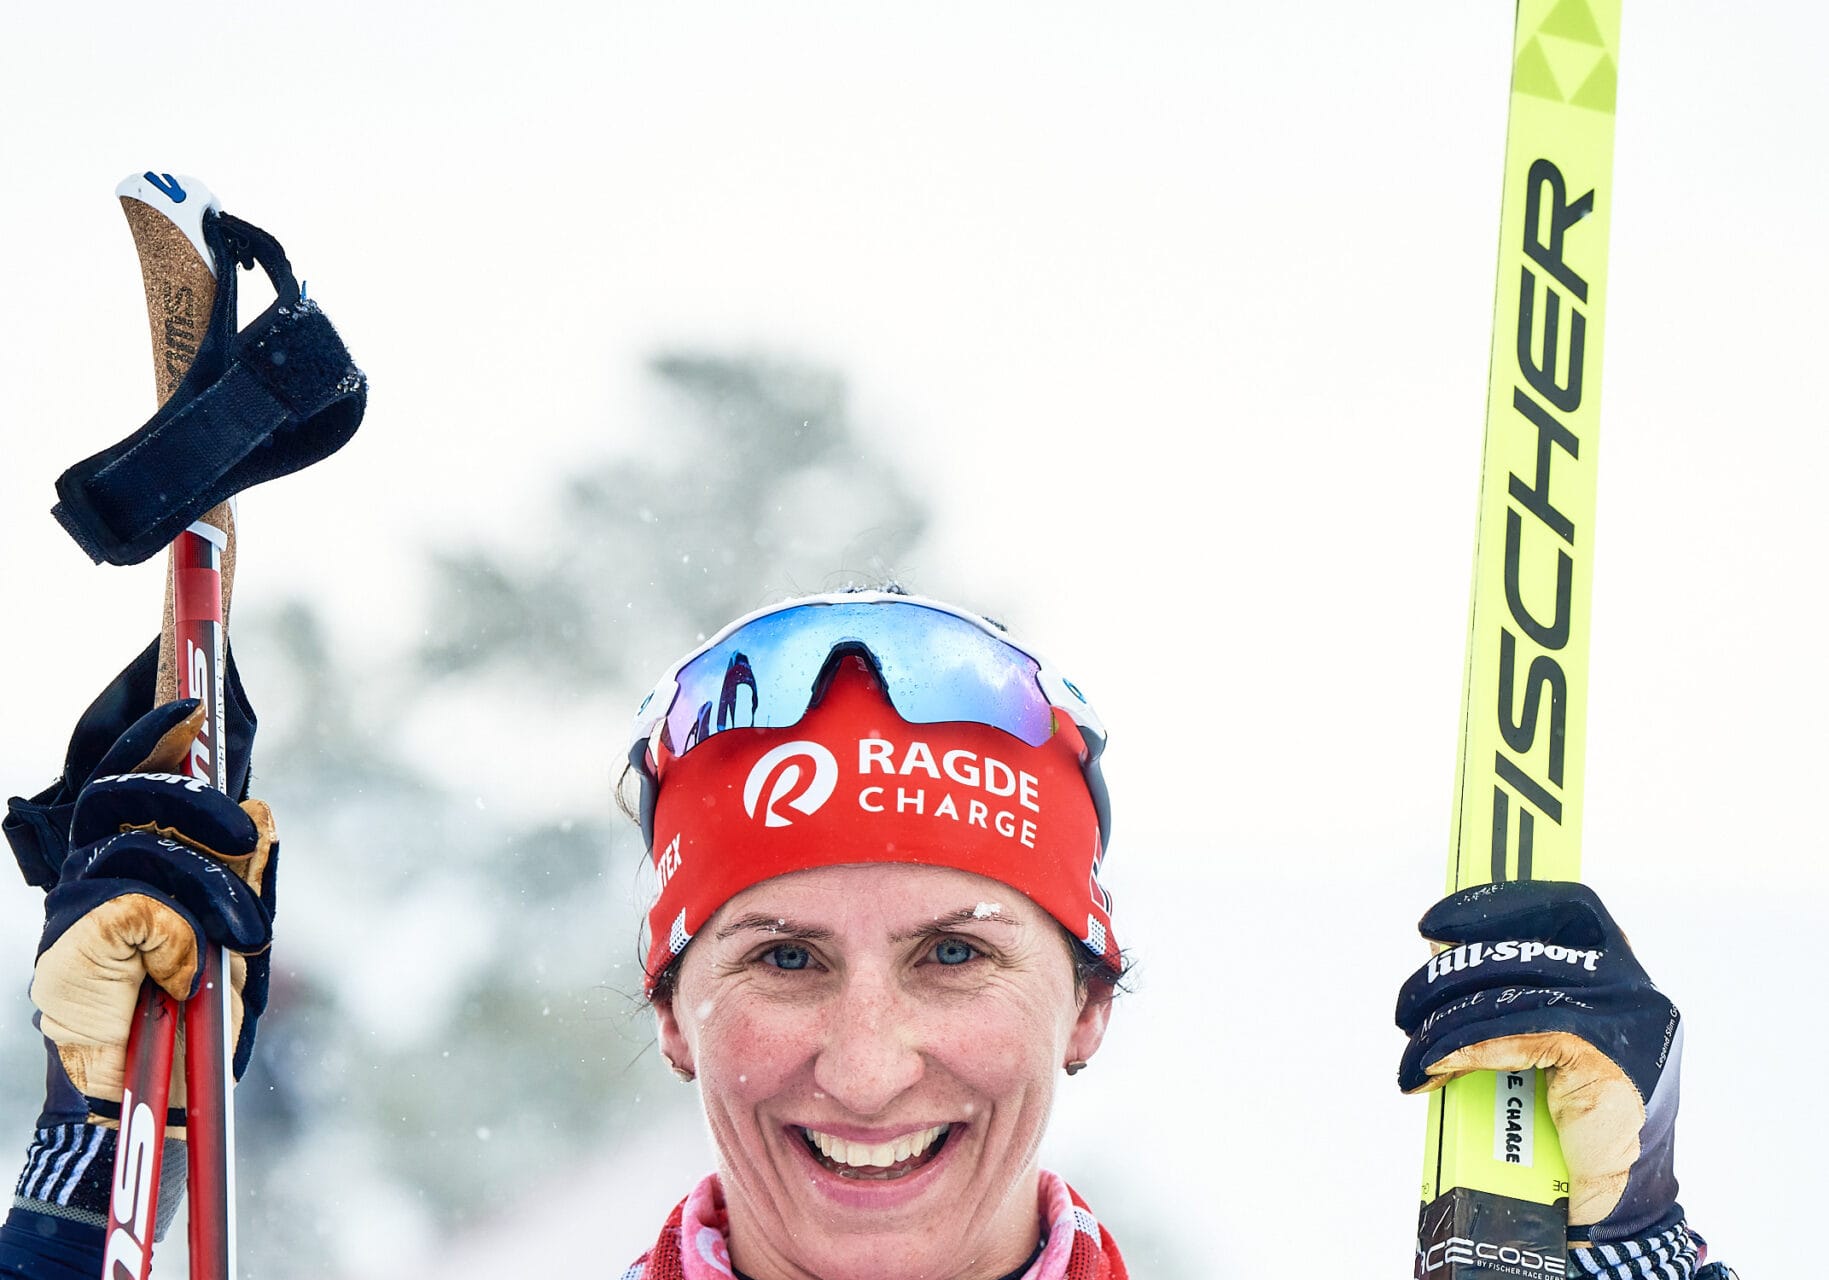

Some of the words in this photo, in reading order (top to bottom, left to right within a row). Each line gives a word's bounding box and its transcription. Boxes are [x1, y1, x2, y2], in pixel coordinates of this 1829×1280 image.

[859, 738, 1040, 813] RAGDE
[859, 786, 1037, 848] CHARGE
[1505, 1097, 1522, 1163] CHARGE
[1488, 1262, 1521, 1275] FISCHER
[1522, 1270, 1542, 1280] RACE
